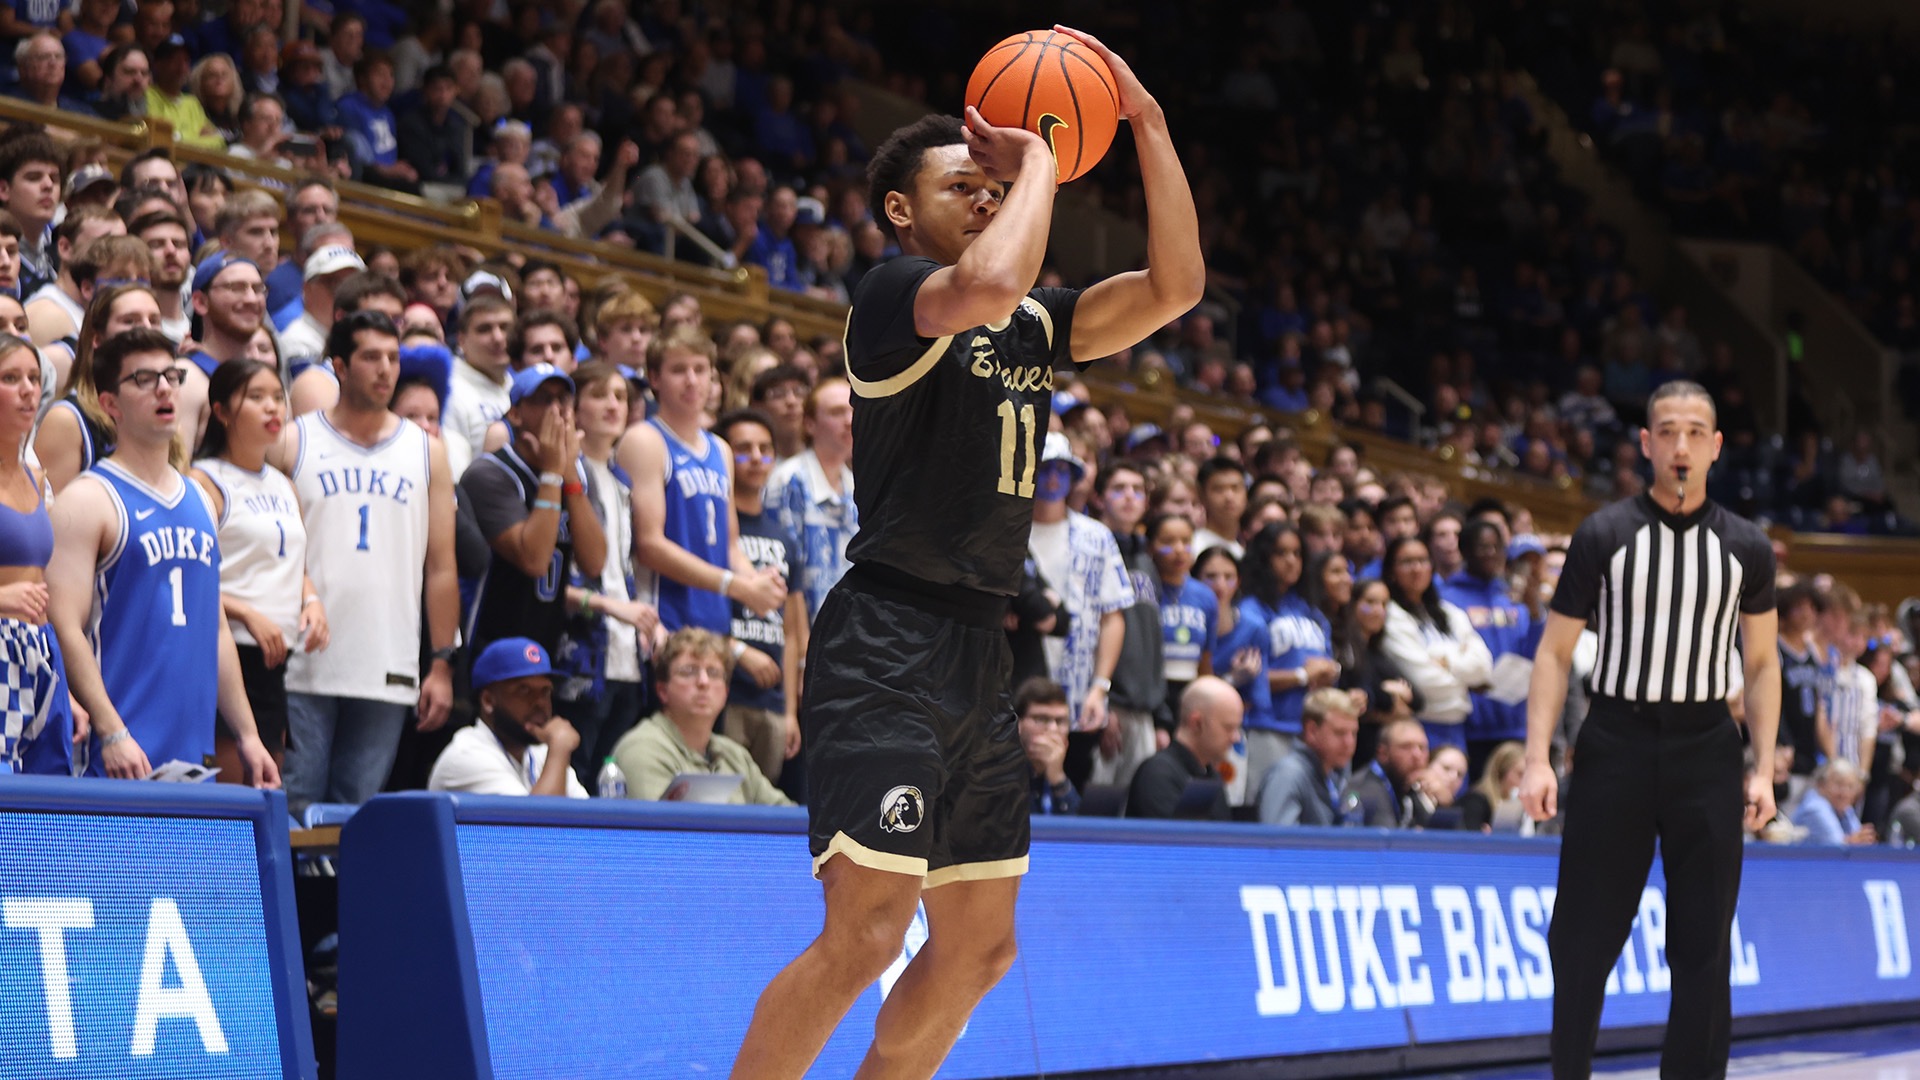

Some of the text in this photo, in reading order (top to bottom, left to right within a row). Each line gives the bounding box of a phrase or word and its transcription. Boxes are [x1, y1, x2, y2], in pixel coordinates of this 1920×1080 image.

[970, 335, 1053, 392] Baves
[996, 398, 1036, 499] 11
[244, 494, 296, 517] DUKE
[317, 467, 414, 505] DUKE
[139, 526, 214, 567] DUKE
[276, 519, 287, 558] 1
[356, 504, 371, 552] 1
[705, 498, 718, 547] 1
[169, 566, 187, 627] 1
[1239, 884, 1435, 1016] DUKE
[2, 896, 229, 1058] TA
